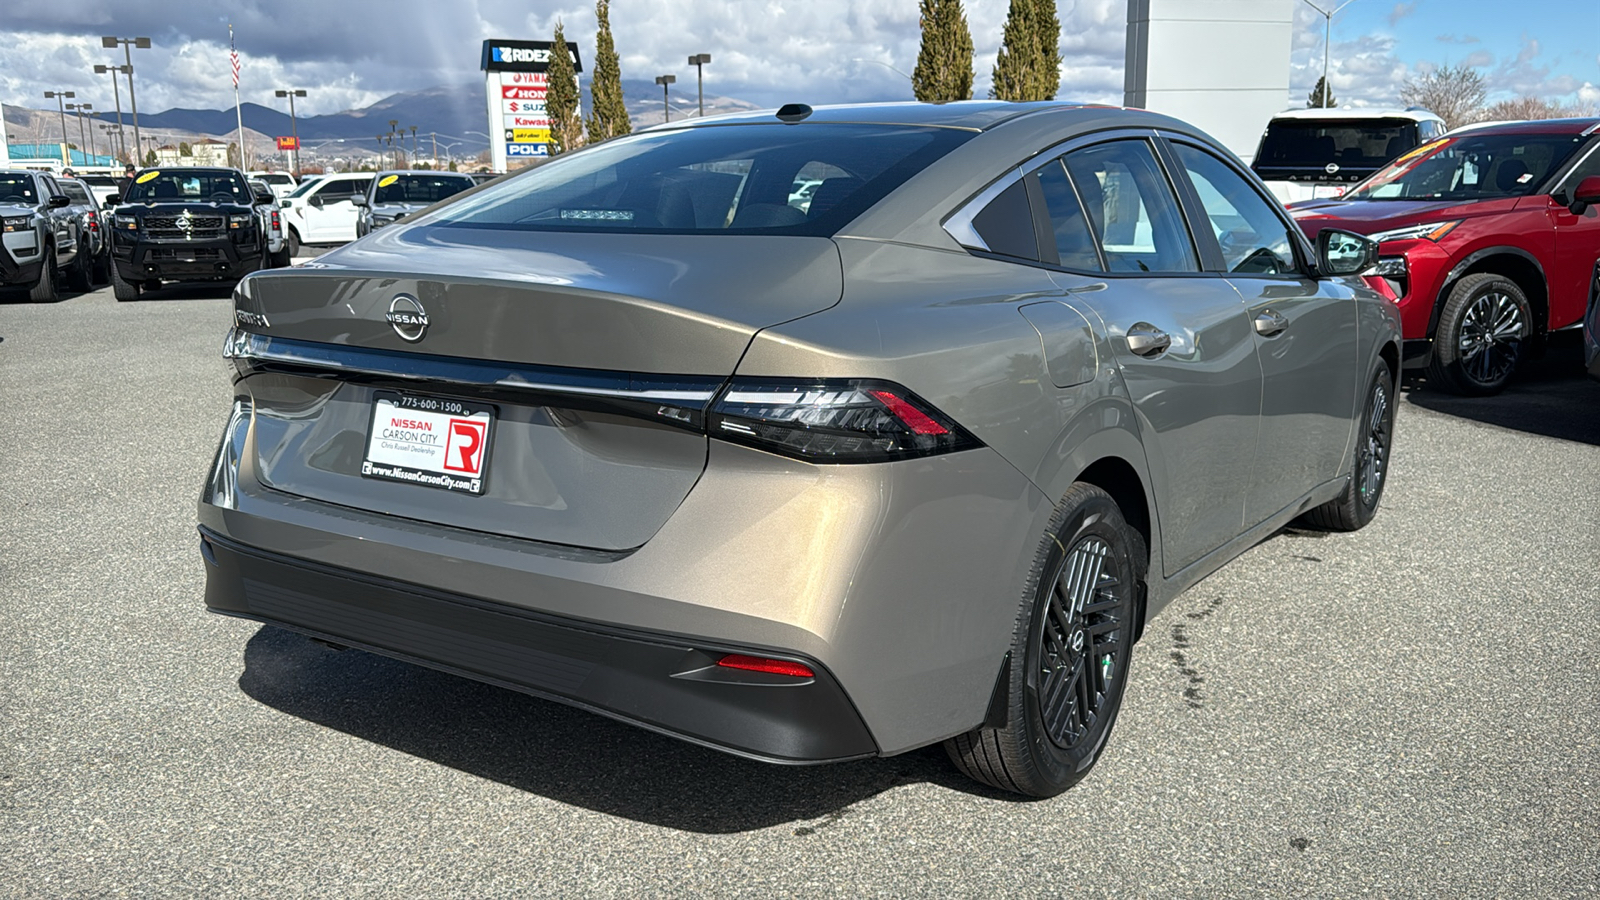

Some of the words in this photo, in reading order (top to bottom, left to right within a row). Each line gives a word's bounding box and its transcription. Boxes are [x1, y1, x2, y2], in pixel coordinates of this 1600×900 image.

[523, 73, 549, 83] YAMA
[518, 90, 548, 99] HON
[385, 313, 428, 325] NISSAN
[401, 397, 462, 413] 775-600-1500
[390, 418, 432, 431] NISSAN
[383, 429, 418, 441] CARSON
[419, 433, 438, 444] CITY
[381, 442, 394, 450] Chris
[394, 443, 410, 451] Russell
[411, 445, 435, 456] Dealership
[371, 465, 470, 489] www.NissanCarsonCity.com
